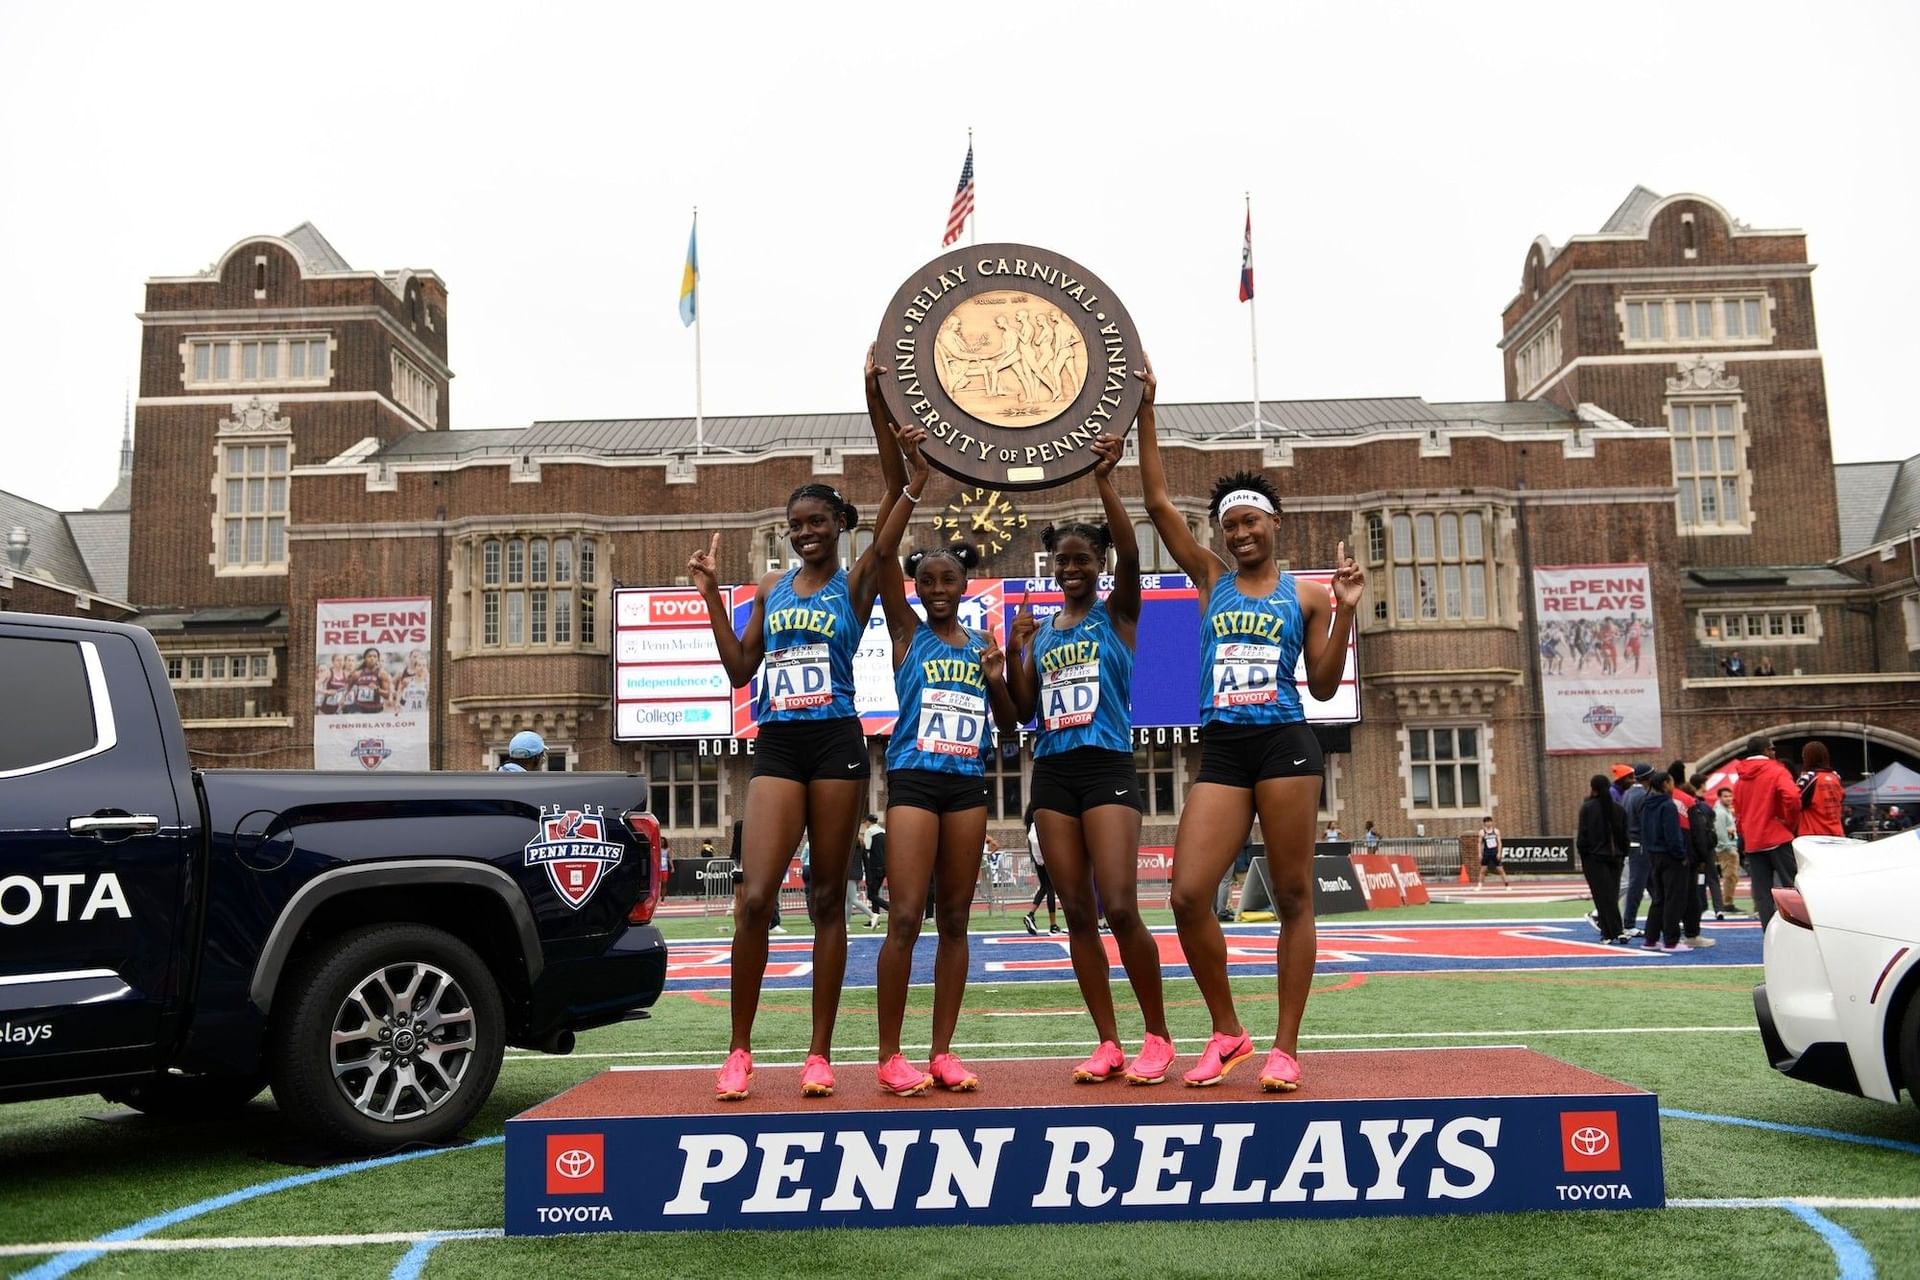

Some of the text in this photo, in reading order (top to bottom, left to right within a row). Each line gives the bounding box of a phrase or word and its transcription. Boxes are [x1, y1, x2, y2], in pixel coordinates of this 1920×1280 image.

[904, 258, 1099, 324] RELAY CARNIVAL
[895, 321, 1128, 464] UNIVERSITY OF PENNSYLVANIA
[1541, 578, 1644, 595] THE PENN
[653, 600, 709, 616] TOYOT
[1543, 595, 1646, 612] RELAYS
[322, 612, 427, 629] THE PENN
[768, 608, 836, 638] HYDEL
[1212, 611, 1284, 643] HYDEL
[324, 628, 427, 646] RELAYS
[672, 638, 713, 650] Medicin
[1041, 641, 1100, 673] HYDEL
[627, 677, 708, 689] Independence
[922, 660, 986, 692] HYDEL
[787, 696, 826, 707] TOYOTA
[1230, 693, 1270, 703] TOYOTA
[636, 708, 682, 726] College
[1060, 713, 1092, 726] TOYOTA
[937, 743, 972, 756] TOYOTA
[529, 844, 620, 860] PENN RELAYS
[1501, 846, 1569, 858] FLOTRACK
[1367, 872, 1396, 890] TOYOTA
[662, 1116, 1502, 1216] PENN RELAYS
[1556, 1184, 1632, 1201] TOYOTA
[537, 1206, 613, 1223] TOYOTA
